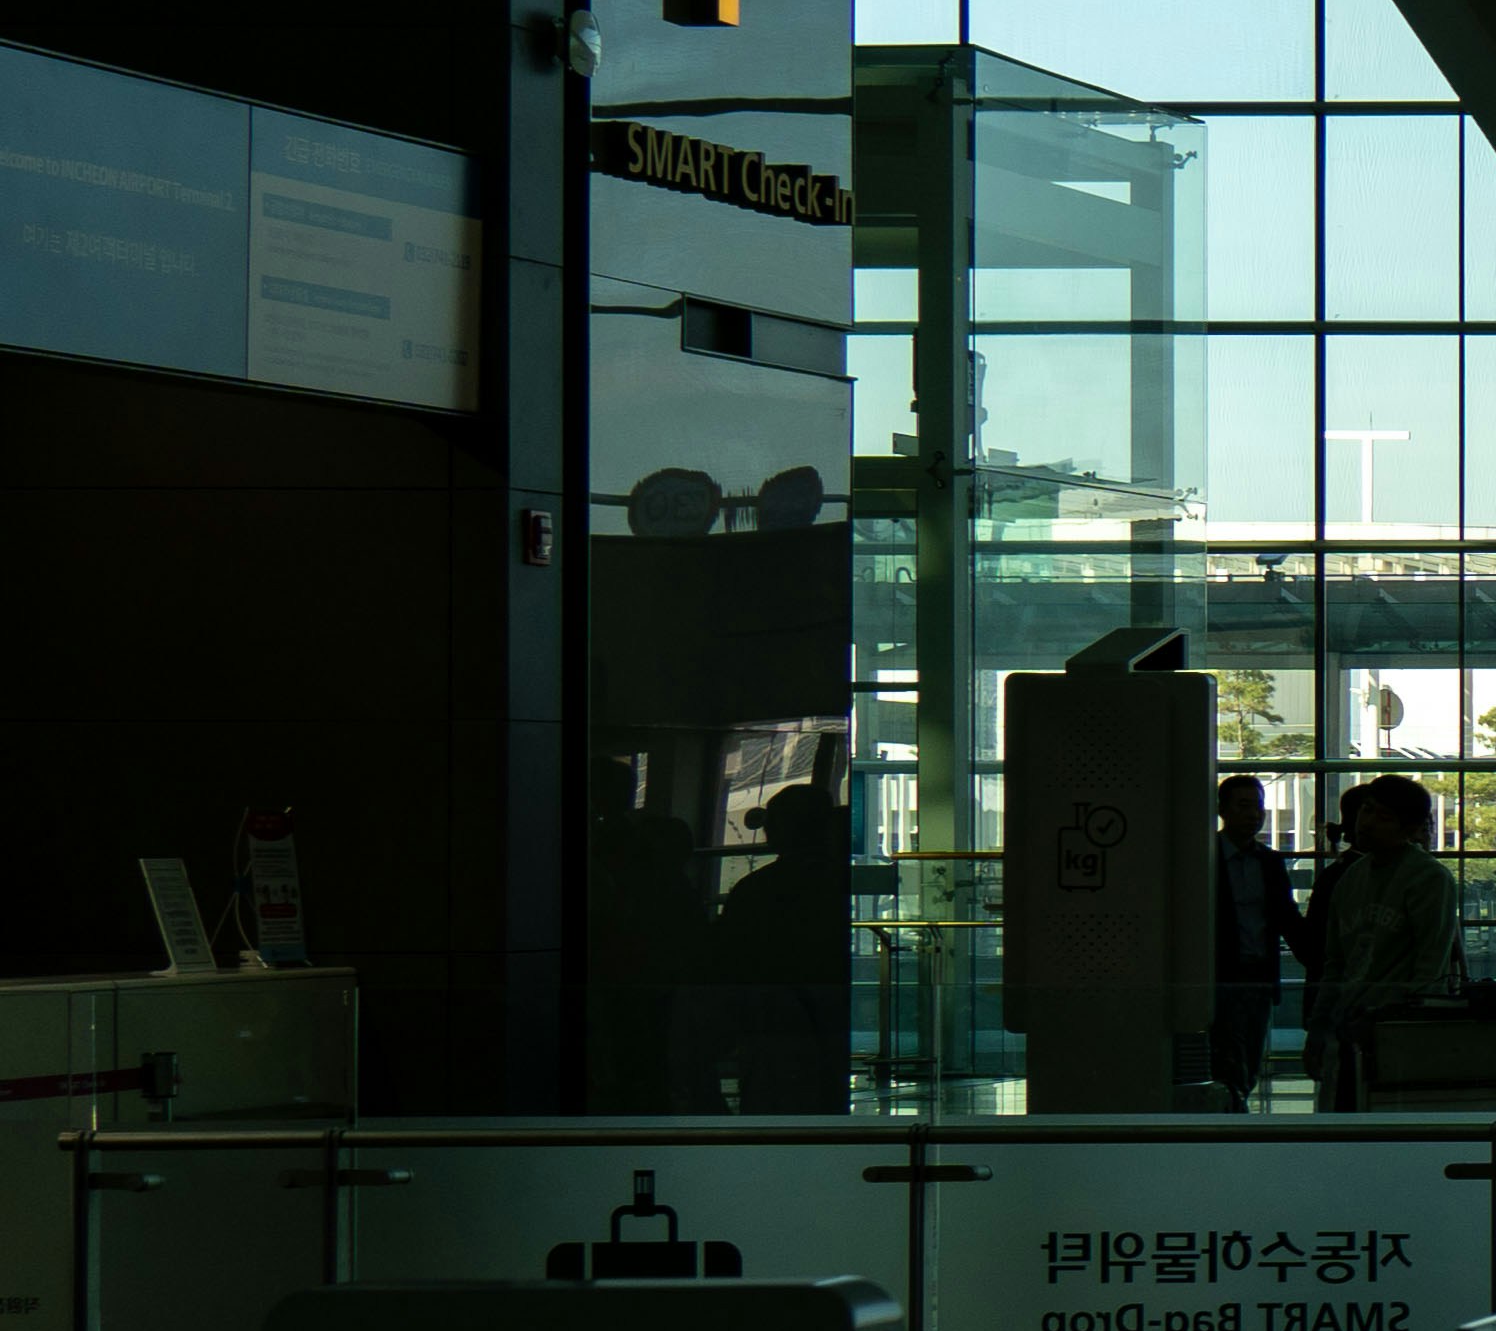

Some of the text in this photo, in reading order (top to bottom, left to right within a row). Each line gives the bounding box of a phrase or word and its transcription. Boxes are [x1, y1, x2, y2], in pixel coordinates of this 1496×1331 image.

[60, 159, 118, 189] INCHEON
[627, 124, 856, 225] SMART Check-In
[1065, 849, 1098, 876] kg
